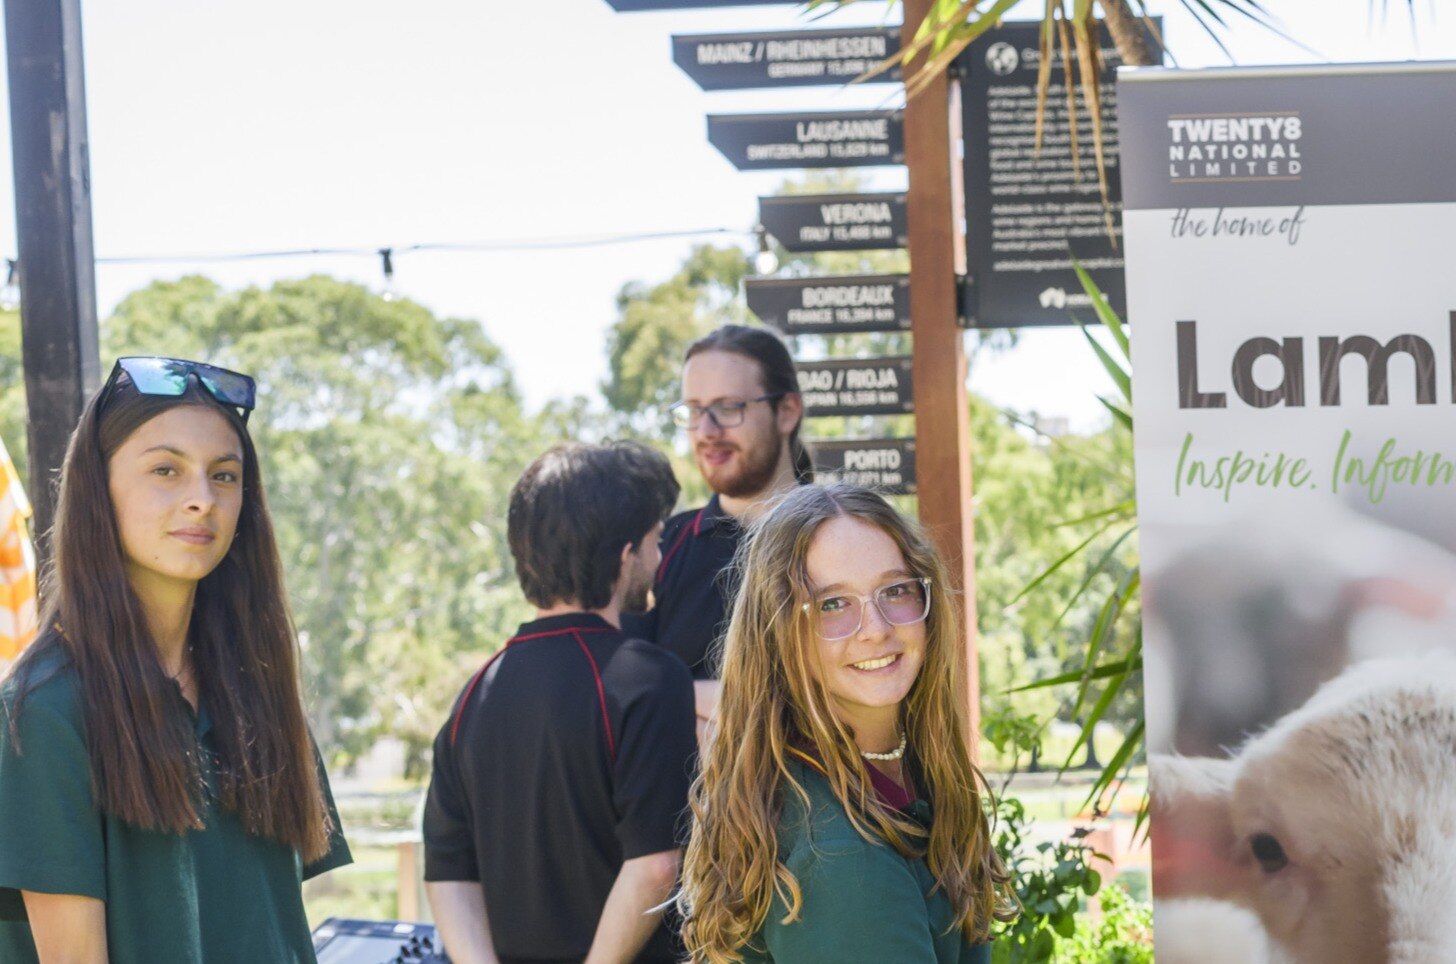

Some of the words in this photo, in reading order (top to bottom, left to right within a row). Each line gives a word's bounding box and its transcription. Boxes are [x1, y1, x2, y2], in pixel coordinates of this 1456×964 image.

[697, 42, 753, 65] MAINZ
[767, 36, 886, 61] RHEINHESSEN
[768, 61, 824, 78] GERMANY
[796, 119, 889, 143] LAUSANNE
[1168, 117, 1302, 143] TWENTY8
[747, 143, 828, 161] SWITZERLAND
[869, 142, 890, 156] km
[1169, 143, 1301, 161] NATIONAL
[1170, 160, 1302, 177] LIMITED
[820, 203, 892, 225] VERONA
[1171, 207, 1208, 238] the
[1212, 207, 1274, 238] home
[1275, 204, 1306, 246] of
[799, 226, 831, 242] ITALY
[871, 225, 892, 239] km
[802, 285, 894, 308] BORDEAUX
[787, 308, 834, 325] FRANCE
[875, 307, 895, 322] km
[846, 368, 899, 390] RIOJA
[878, 391, 899, 405] km
[844, 448, 901, 470] PORTO
[1174, 432, 1317, 503] Inspire.
